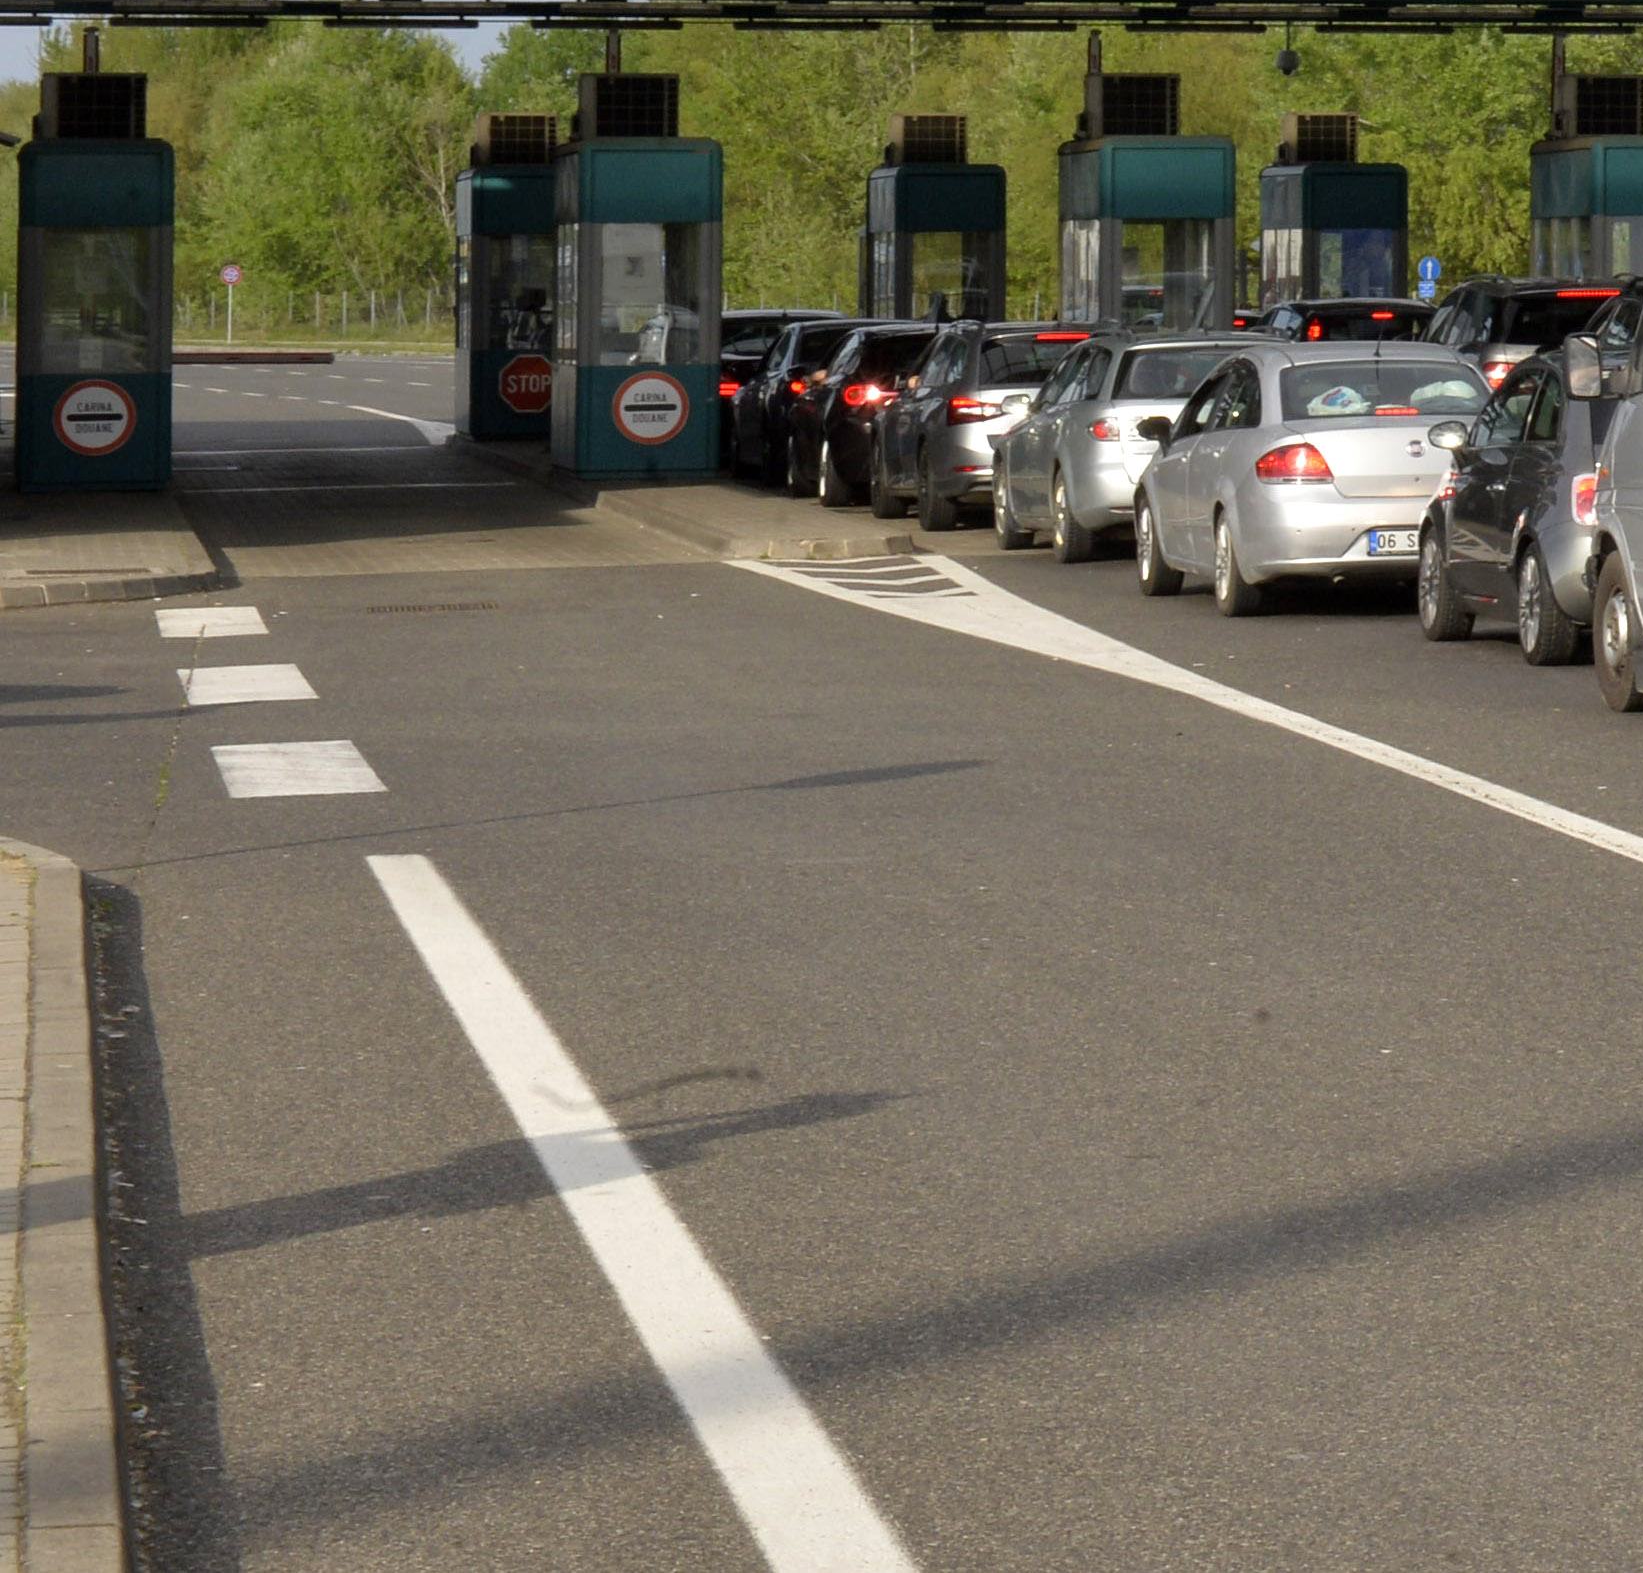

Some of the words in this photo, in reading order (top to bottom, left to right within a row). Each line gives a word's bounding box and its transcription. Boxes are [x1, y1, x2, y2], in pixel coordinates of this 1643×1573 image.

[507, 375, 551, 394] STOP
[632, 413, 668, 423] DOUANE
[1378, 534, 1396, 548] 06
